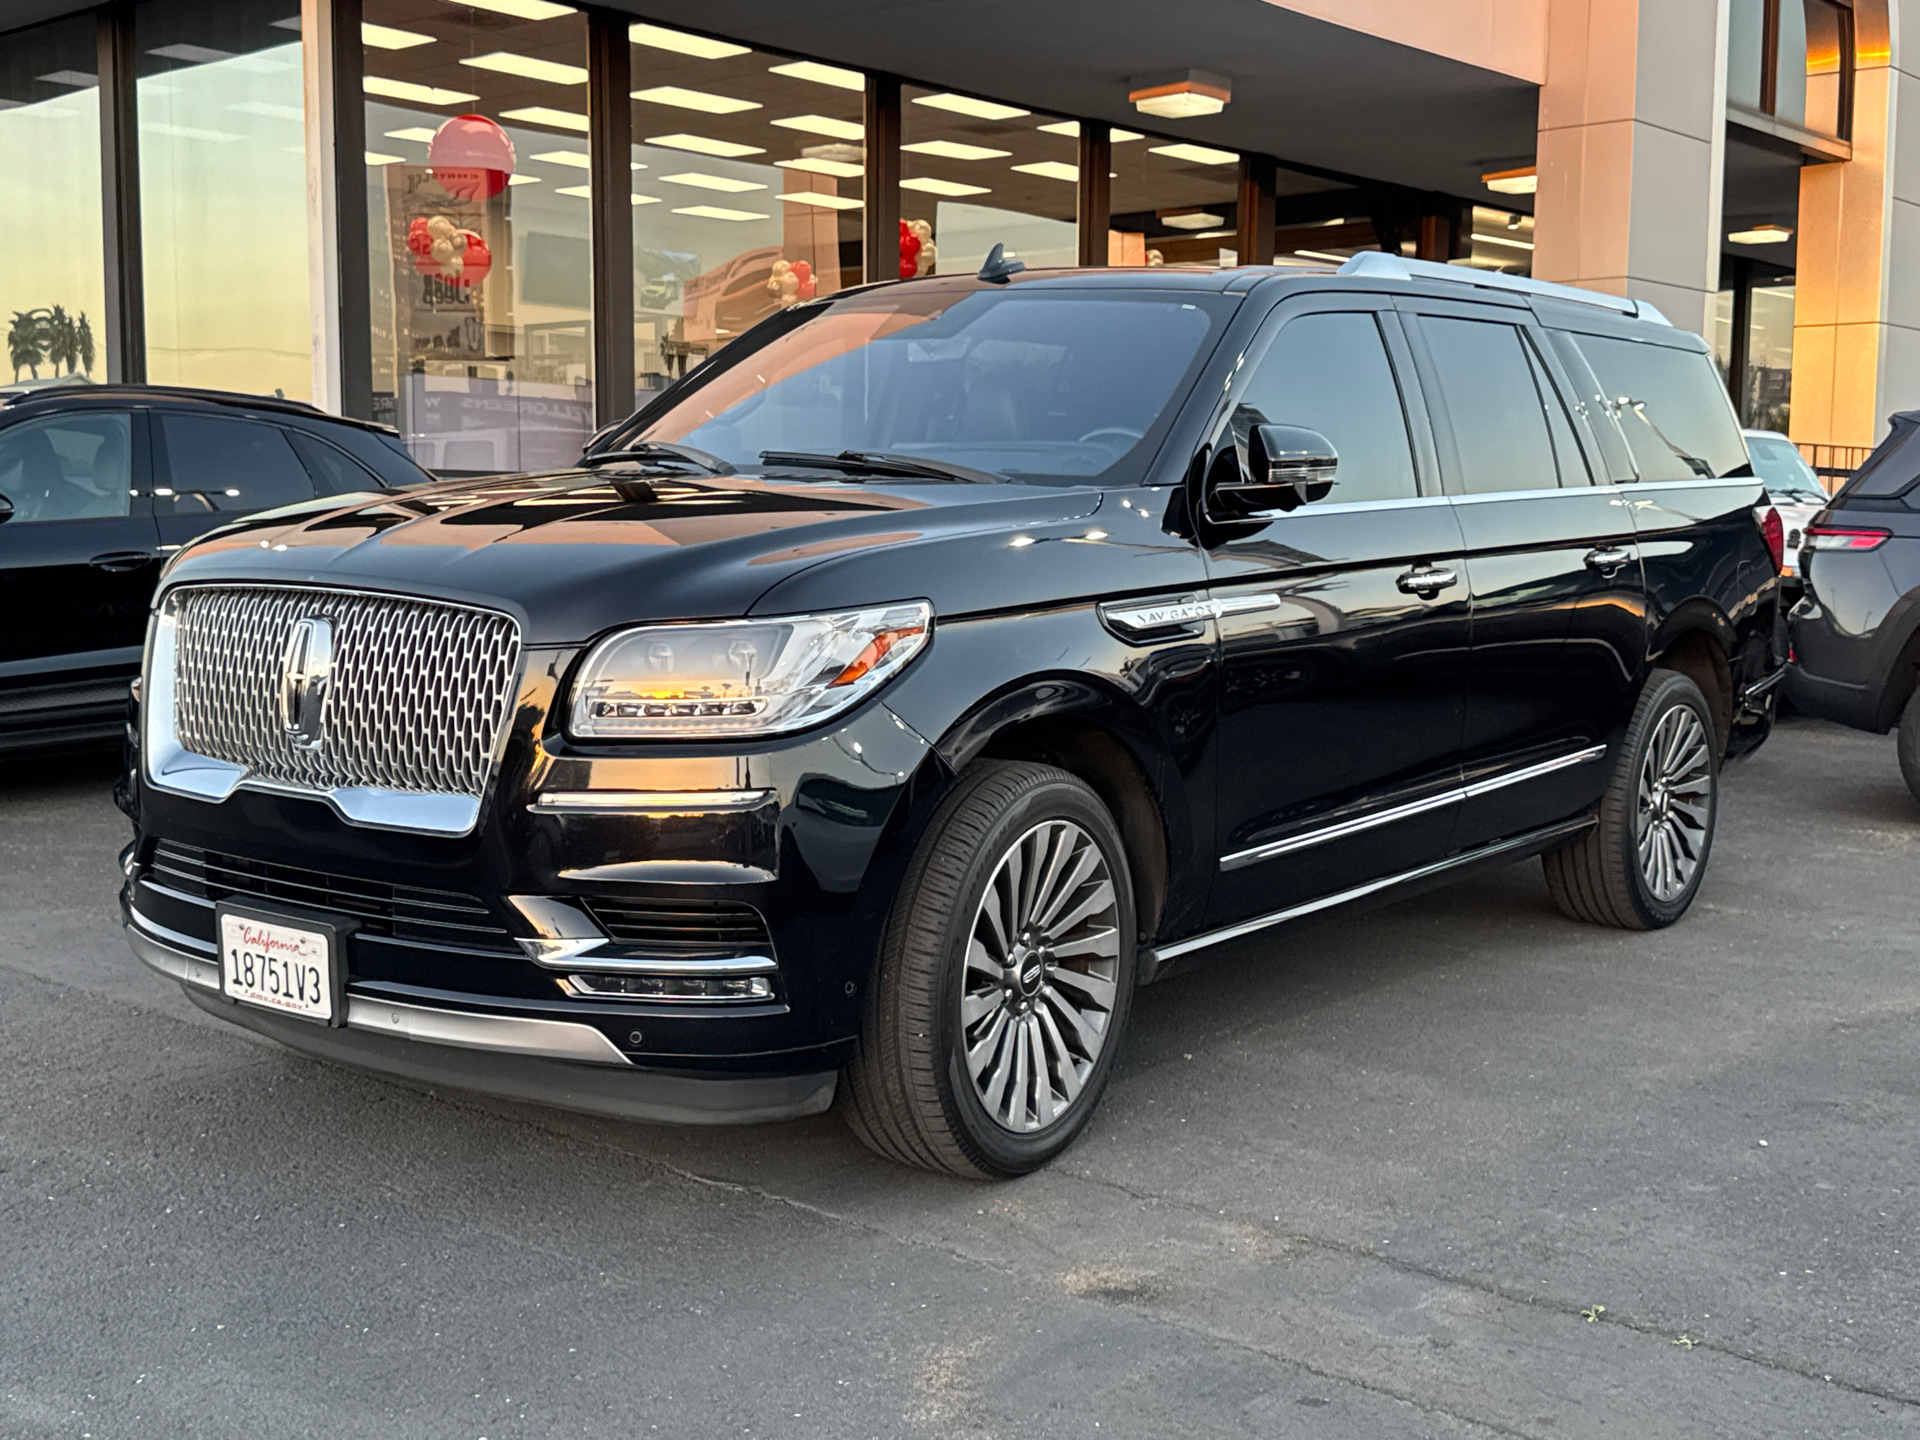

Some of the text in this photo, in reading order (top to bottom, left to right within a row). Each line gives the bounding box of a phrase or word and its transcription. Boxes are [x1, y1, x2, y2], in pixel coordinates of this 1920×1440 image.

[1136, 604, 1213, 624] NAVGATOR
[243, 926, 308, 956] California
[231, 948, 321, 1004] 18751V3
[250, 992, 302, 1009] dmv.ca.gov
